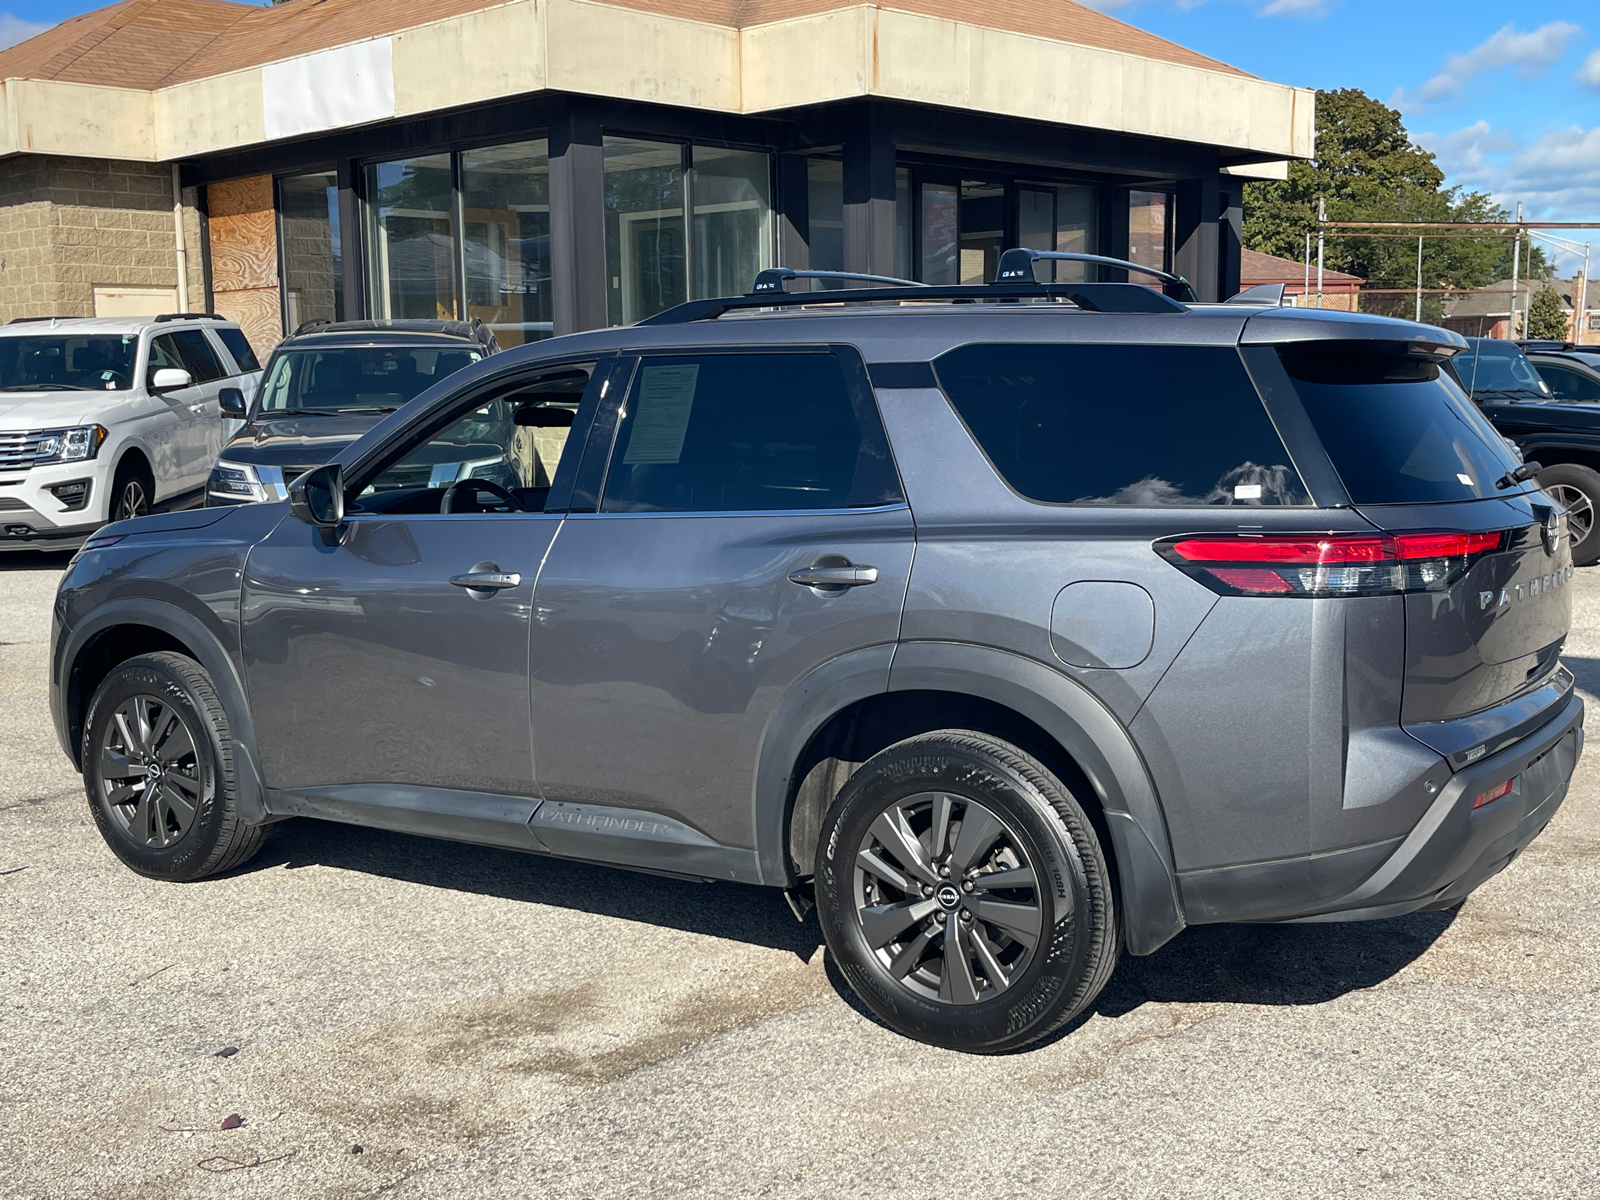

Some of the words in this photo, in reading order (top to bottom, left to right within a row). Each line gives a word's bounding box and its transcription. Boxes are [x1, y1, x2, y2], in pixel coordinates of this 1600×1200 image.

[1479, 560, 1574, 610] PATHFIN
[540, 809, 669, 835] PATHFINDER
[1052, 867, 1067, 899] 108H
